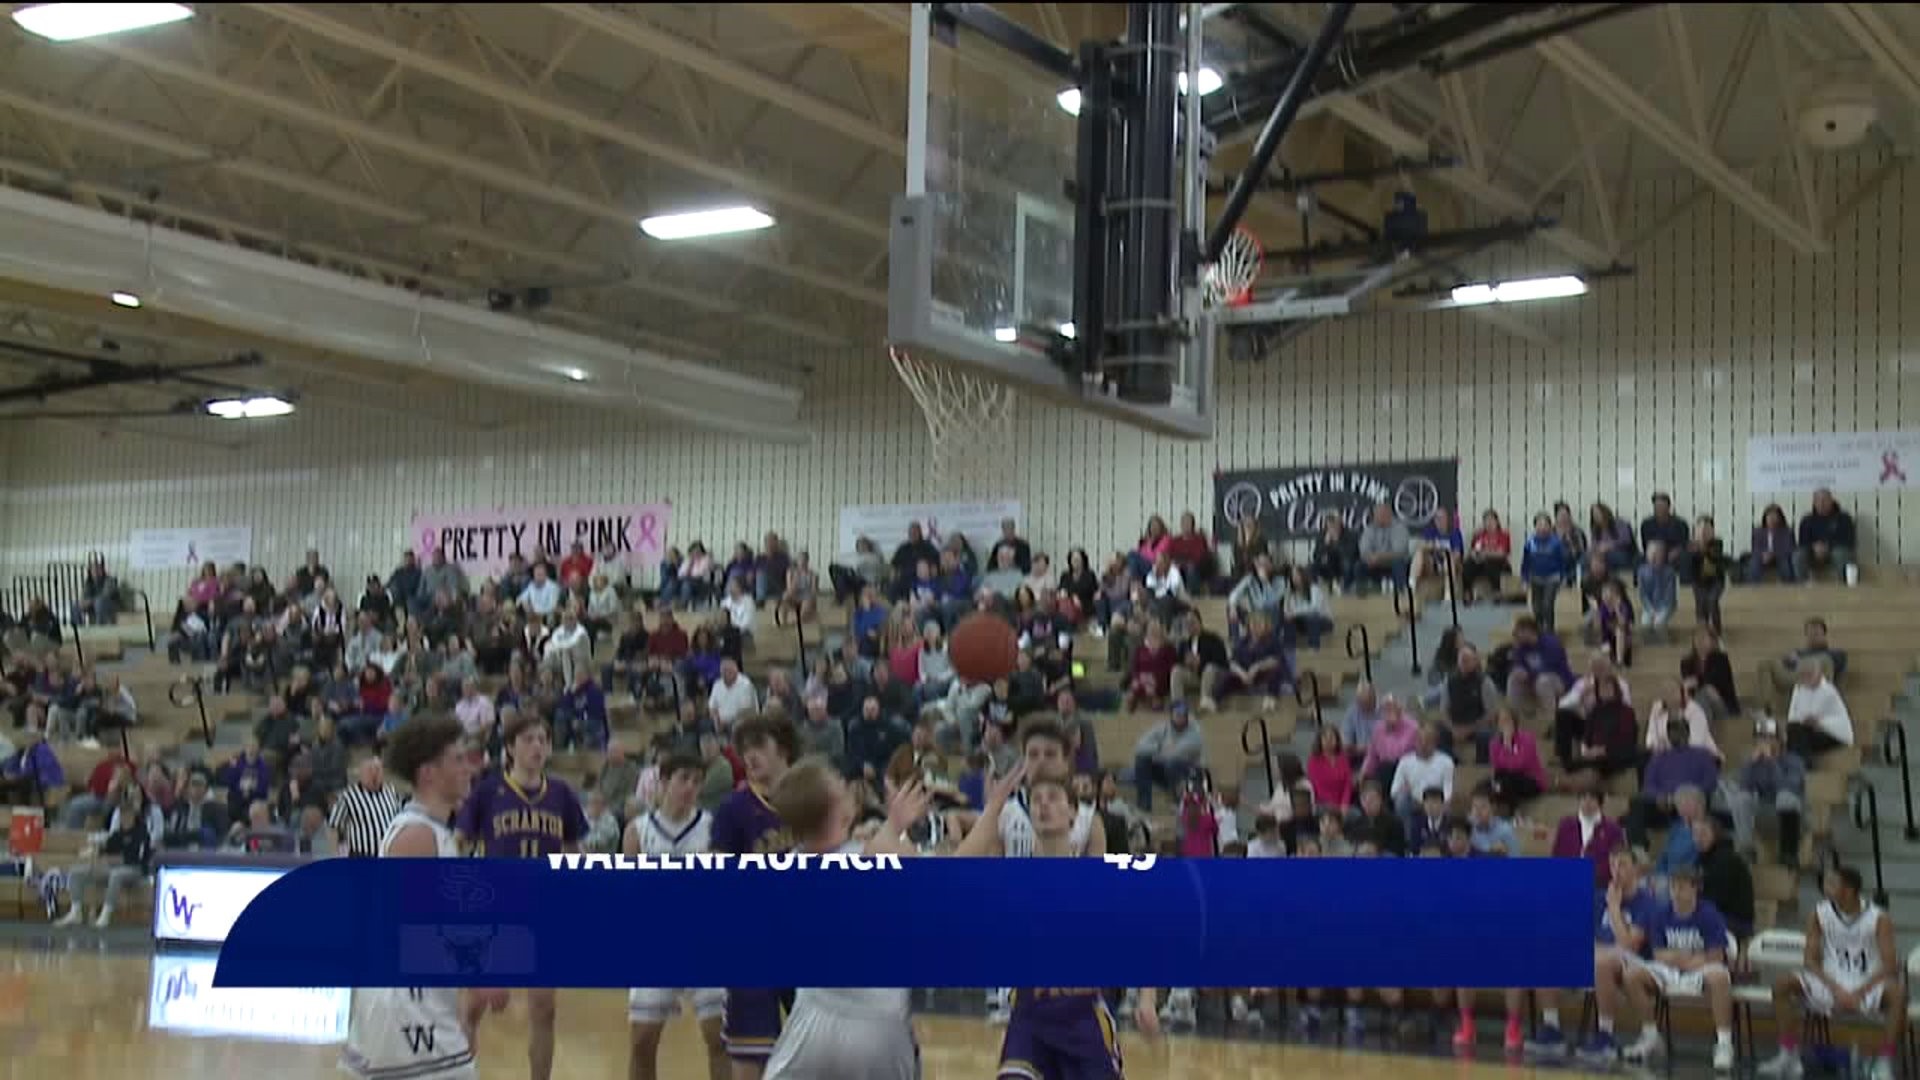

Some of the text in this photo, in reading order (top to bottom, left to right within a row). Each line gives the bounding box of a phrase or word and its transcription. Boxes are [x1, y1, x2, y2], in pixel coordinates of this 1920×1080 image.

[1269, 470, 1391, 510] PRETTY IN PINK
[441, 515, 632, 562] PRETTY IN PINK
[401, 1022, 436, 1055] W
